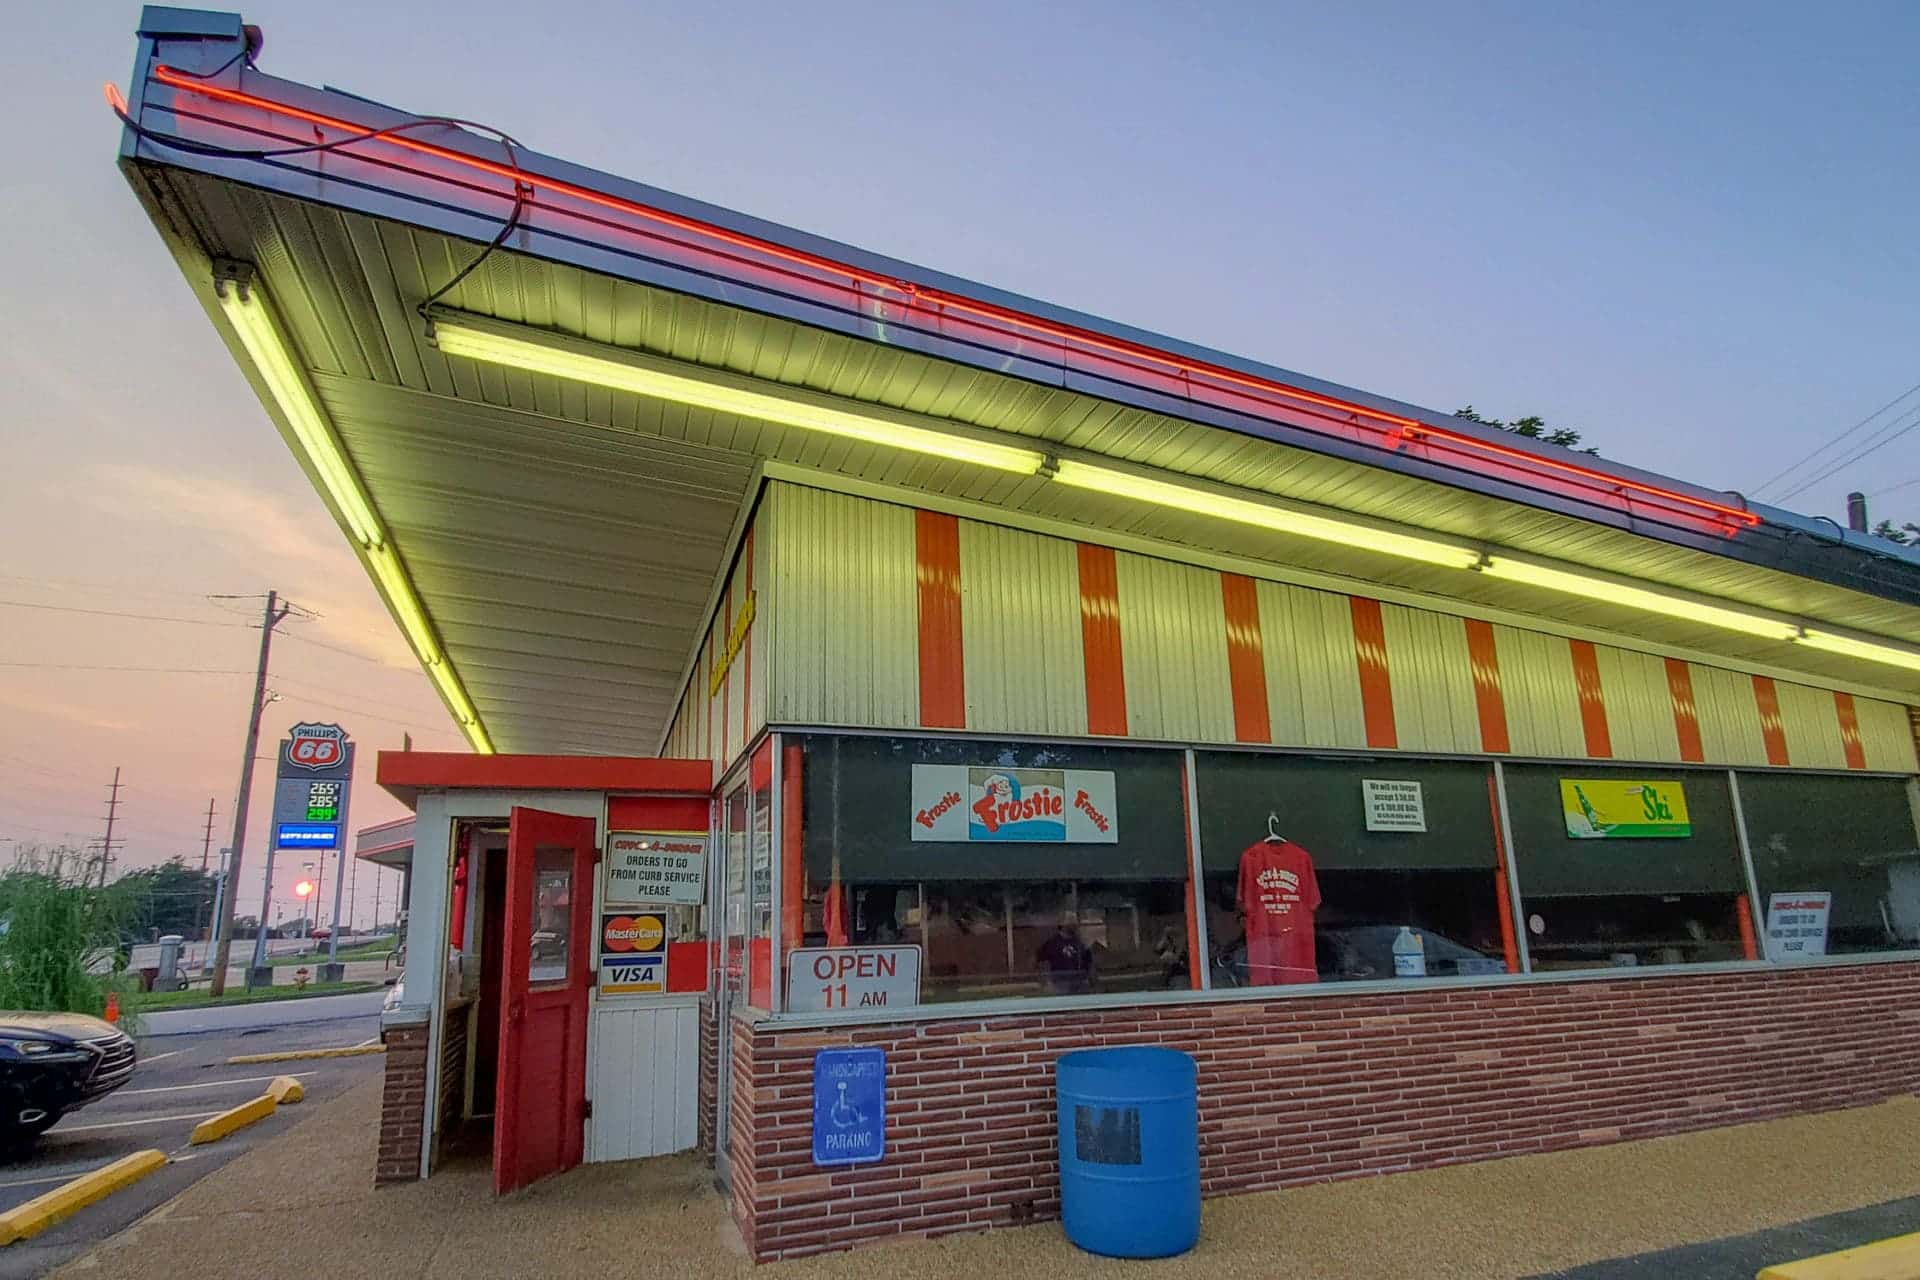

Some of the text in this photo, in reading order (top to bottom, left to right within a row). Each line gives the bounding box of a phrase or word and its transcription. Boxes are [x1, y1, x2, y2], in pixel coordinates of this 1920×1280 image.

[297, 727, 338, 738] PHILLIPS
[297, 741, 335, 760] 66
[916, 791, 962, 829] Frostie
[973, 787, 1063, 833] Frostie
[1073, 789, 1109, 833] Frostie
[1641, 784, 1674, 821] Ski
[626, 855, 689, 868] ORDERS TO GO
[611, 869, 700, 883] FROM CURB SERVICE
[638, 885, 671, 896] PLEASE
[606, 929, 663, 940] MasterCard
[611, 967, 654, 983] VISA
[813, 952, 896, 980] OPEN
[821, 983, 888, 1008] 11 AM
